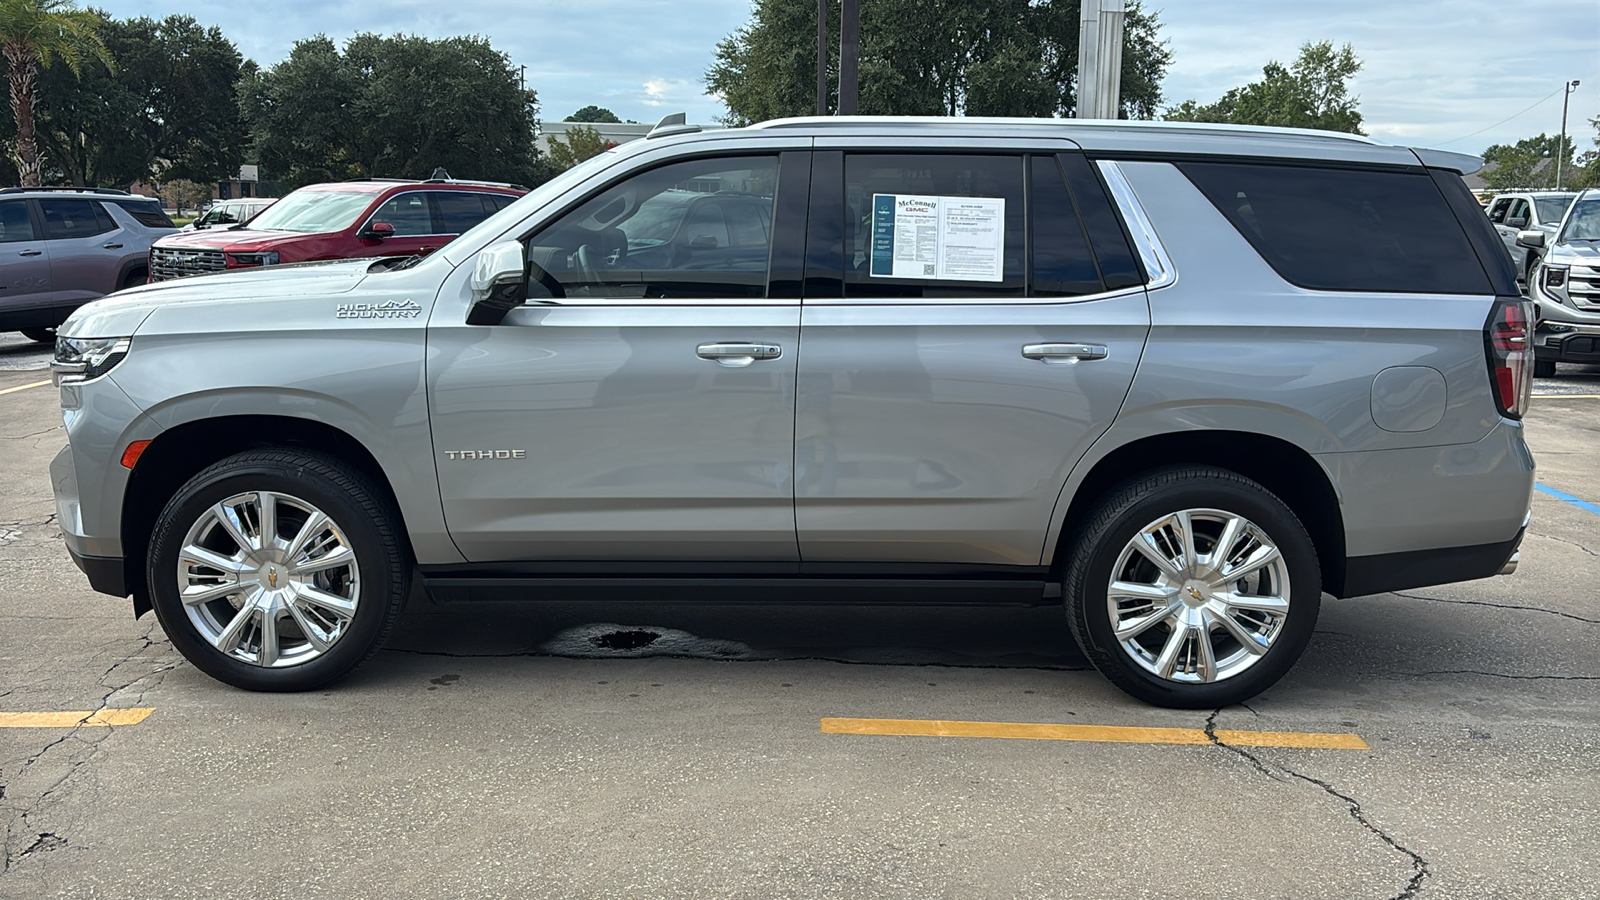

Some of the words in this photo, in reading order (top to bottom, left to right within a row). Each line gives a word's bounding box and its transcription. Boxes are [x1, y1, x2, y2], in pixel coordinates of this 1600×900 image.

[898, 199, 937, 209] McConnell
[336, 303, 379, 311] HIGH
[336, 310, 422, 319] COUNTRY
[444, 449, 527, 461] TAHOE
